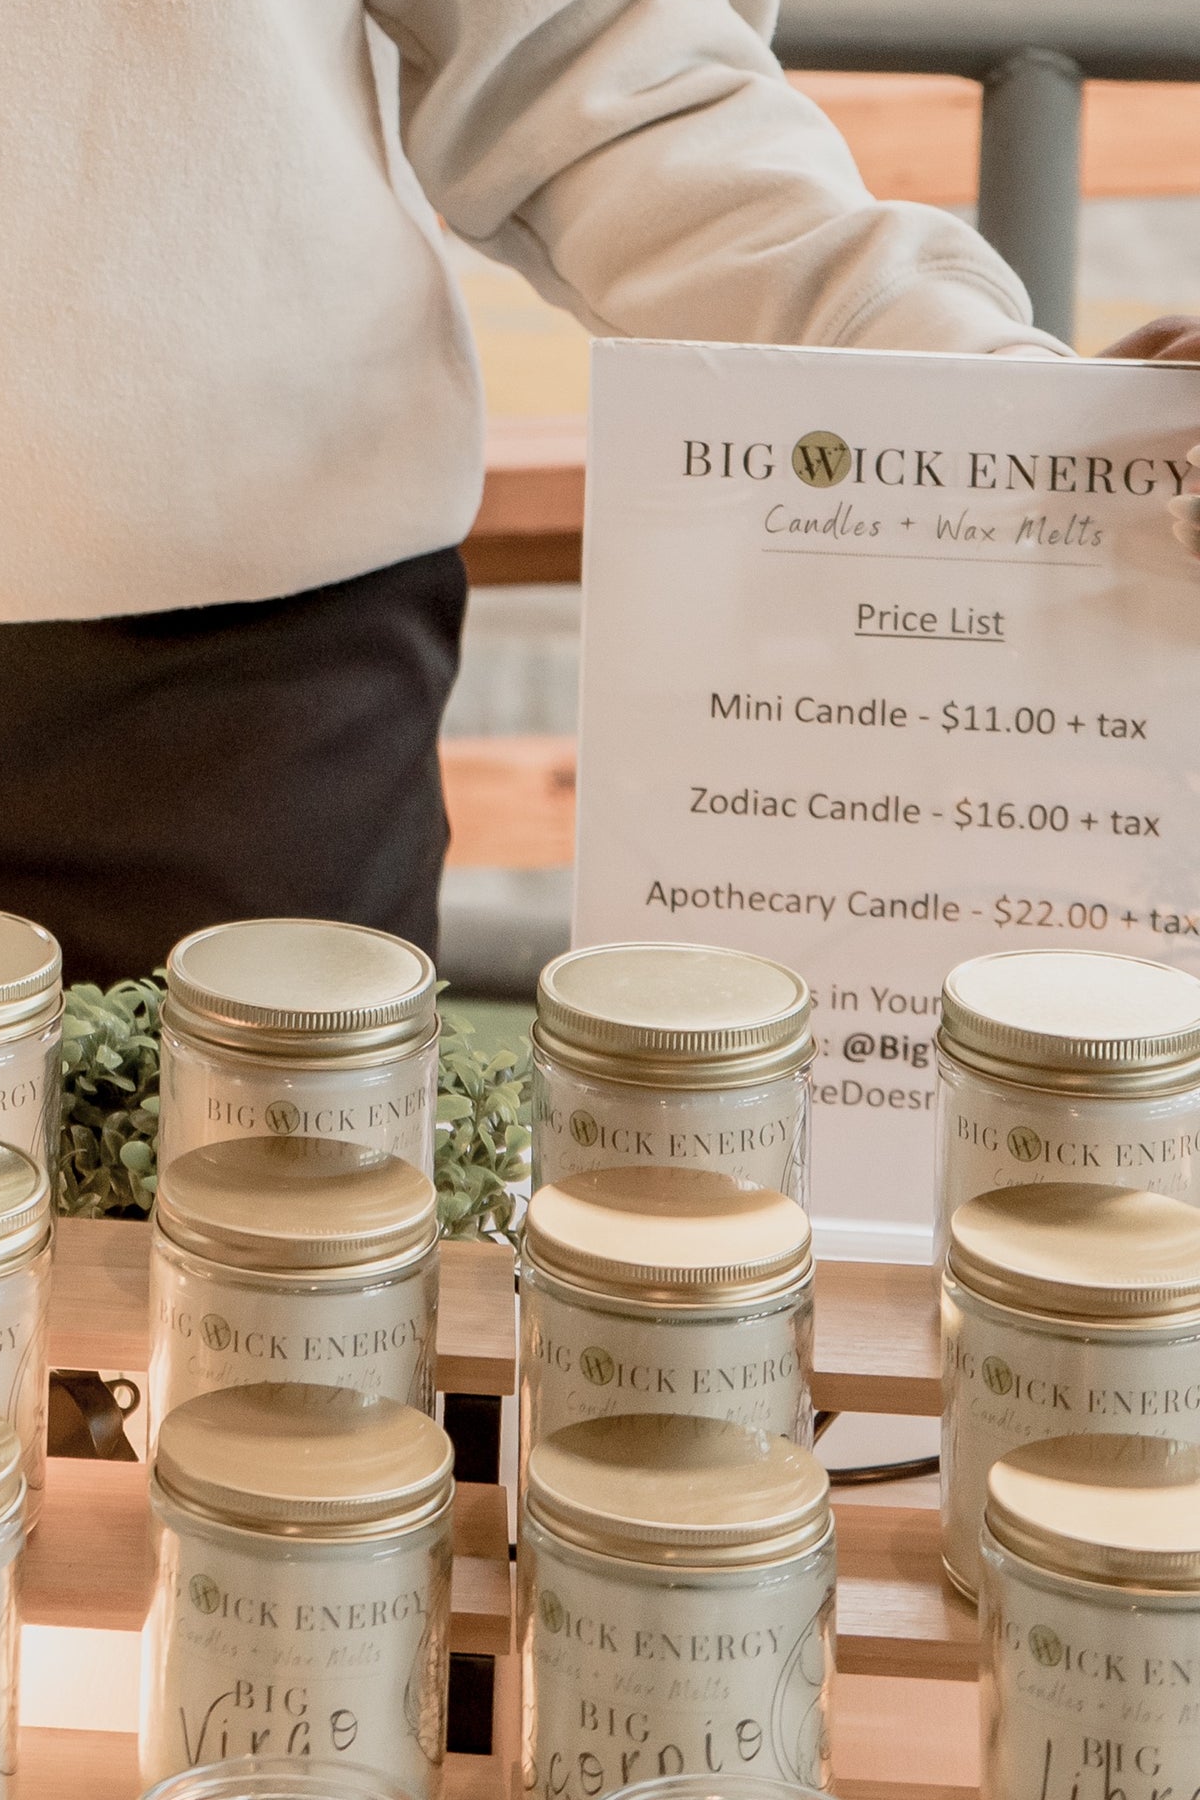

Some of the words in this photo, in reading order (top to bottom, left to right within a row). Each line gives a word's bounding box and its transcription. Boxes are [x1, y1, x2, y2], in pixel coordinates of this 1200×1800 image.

[682, 439, 775, 480] BIG
[797, 443, 946, 489] WICK
[967, 451, 1193, 496] ENERGY
[764, 500, 882, 540] Candles
[935, 509, 996, 542] Wax
[1014, 513, 1103, 547] Melts
[857, 602, 938, 634] Price
[950, 607, 1005, 636] List
[710, 691, 783, 722] Mini
[794, 696, 908, 728] Candle
[941, 699, 1056, 736] $11.00
[1096, 713, 1147, 740] tax
[689, 786, 797, 818] Zodiac
[807, 792, 921, 825] Candle
[954, 797, 1070, 833] $16.00
[1109, 810, 1160, 838] tax
[645, 880, 836, 922] Apothecary
[847, 890, 960, 922] Candle
[994, 894, 1109, 930] $22.00
[1148, 908, 1200, 936] tax
[831, 984, 859, 1011] in
[207, 1096, 255, 1128] BIG
[957, 1115, 999, 1152] BIG
[670, 1115, 793, 1158] ENERGY
[295, 1586, 428, 1633] ENERGY
[635, 1625, 784, 1662] ENERGY
[234, 1679, 309, 1717] BIG
[580, 1700, 649, 1743] BIG
